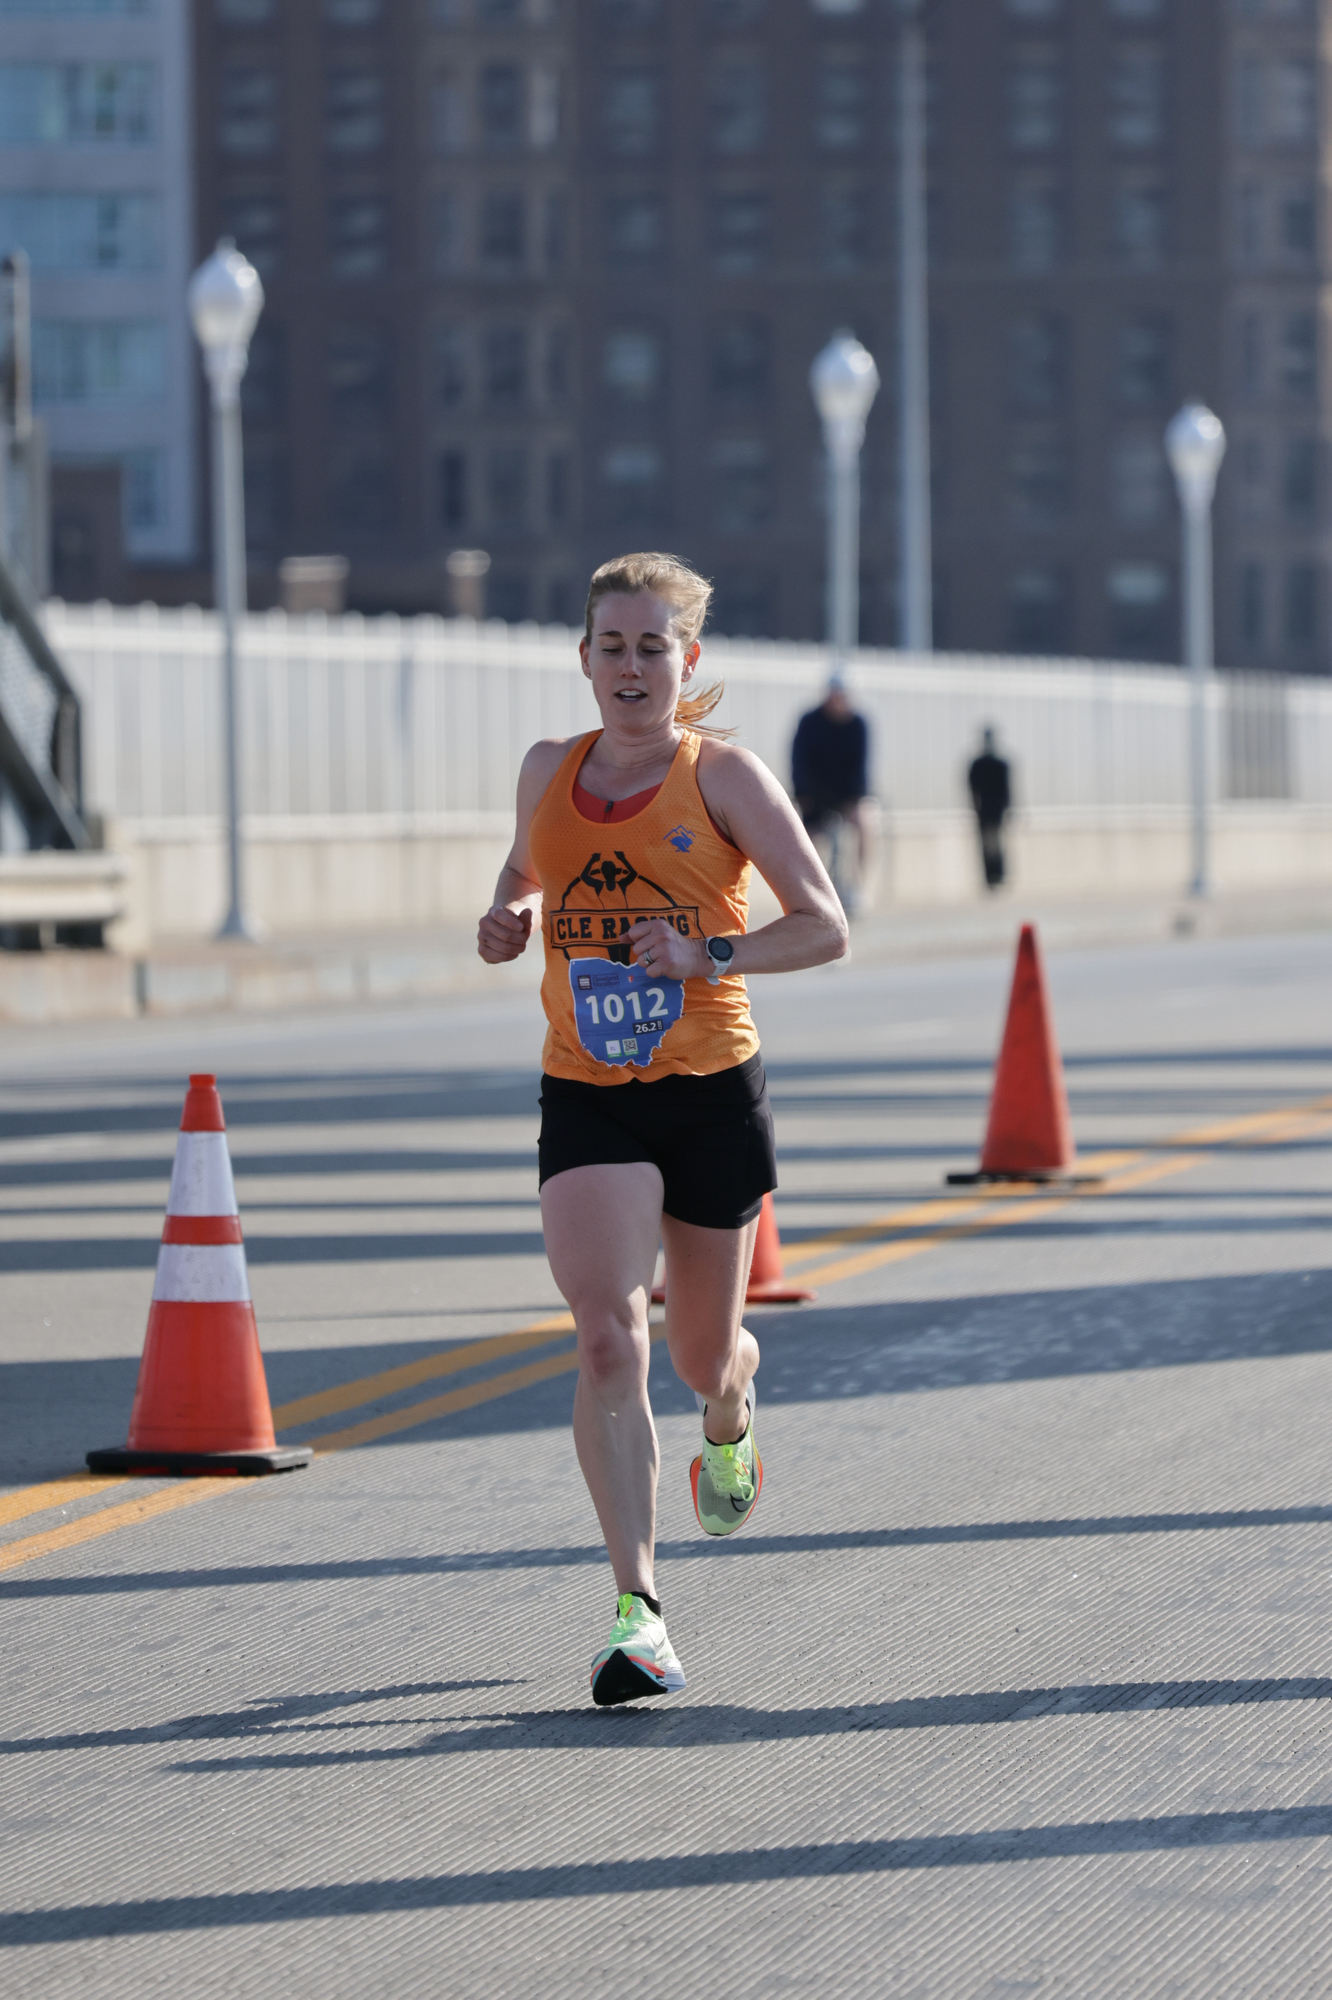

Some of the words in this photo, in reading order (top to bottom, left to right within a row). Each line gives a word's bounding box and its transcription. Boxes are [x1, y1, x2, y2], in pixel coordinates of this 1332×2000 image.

[557, 917, 592, 940] CLE
[601, 914, 690, 939] RAG
[585, 987, 669, 1024] 1012
[635, 1022, 657, 1034] 26.2
